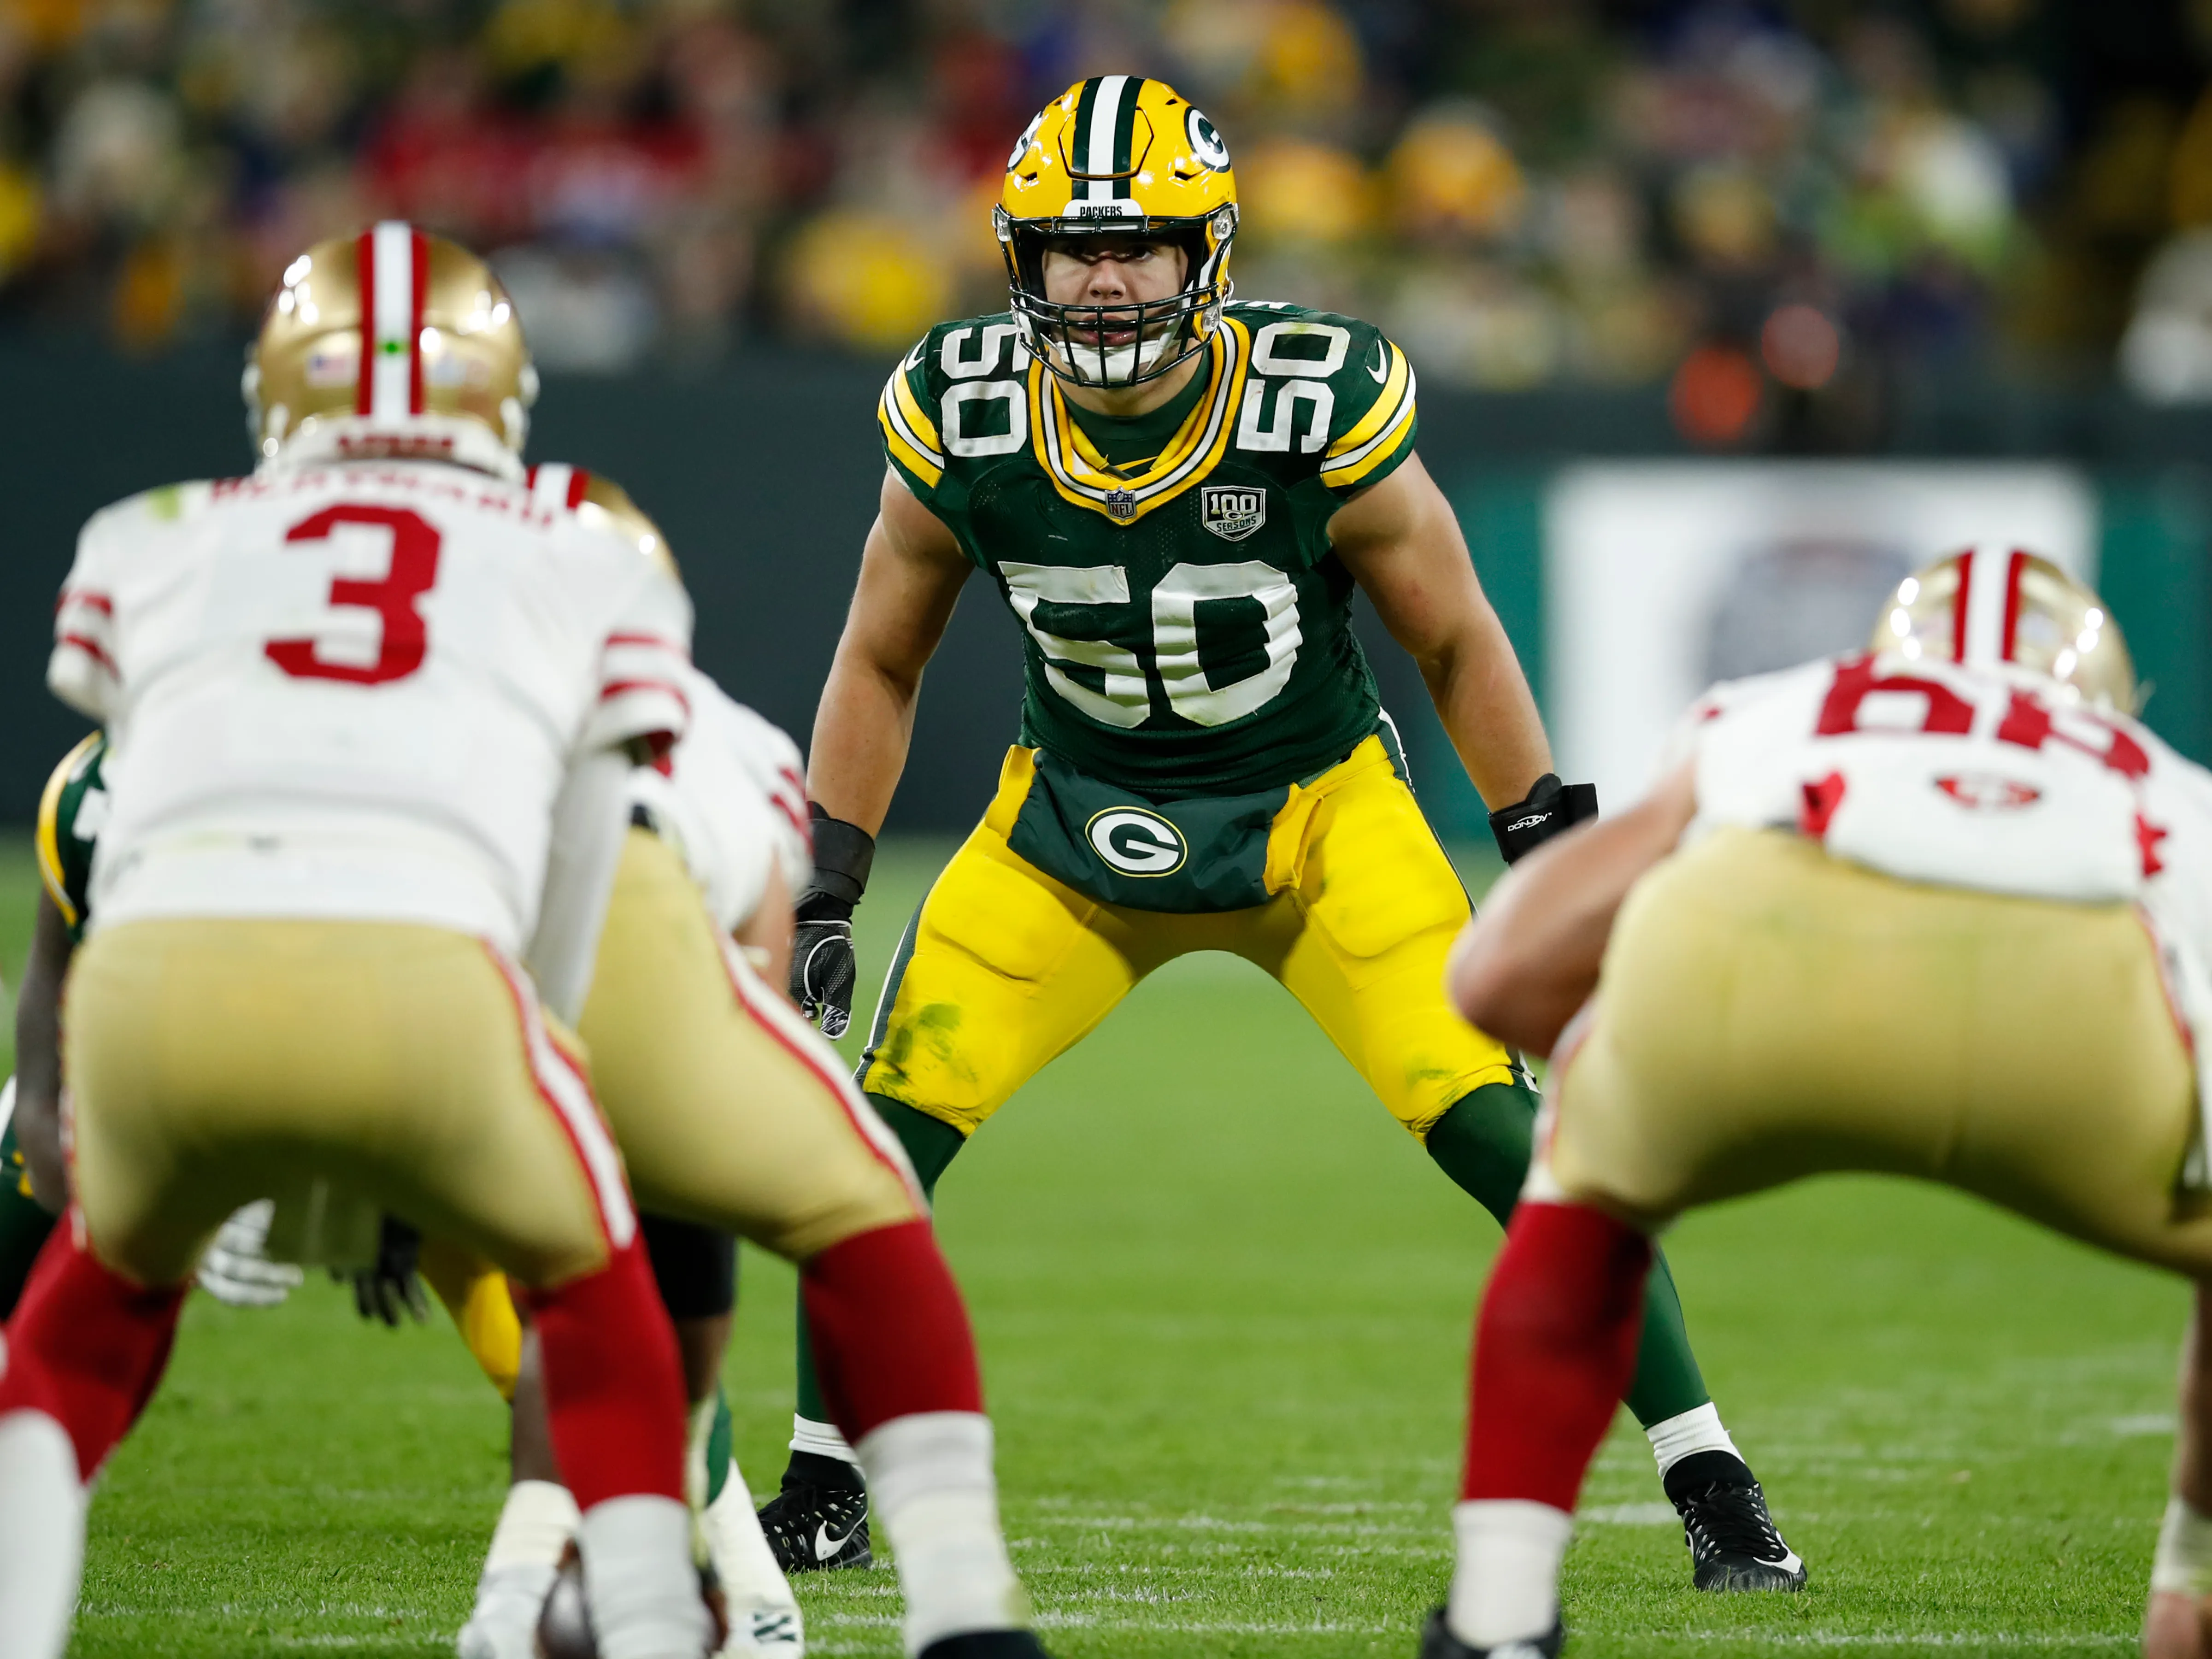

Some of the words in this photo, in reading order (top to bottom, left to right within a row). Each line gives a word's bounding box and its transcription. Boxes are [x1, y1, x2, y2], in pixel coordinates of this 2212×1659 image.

[1080, 206, 1123, 216] PACKERS
[941, 324, 1030, 457] 50
[1236, 322, 1350, 454] 50
[1111, 504, 1132, 515] NFL
[1211, 494, 1257, 515] 100
[1217, 516, 1256, 531] SEASONS
[264, 504, 441, 685] 3
[998, 560, 1303, 729] 50
[1091, 813, 1180, 871] G
[1508, 813, 1548, 832] DONJOY
